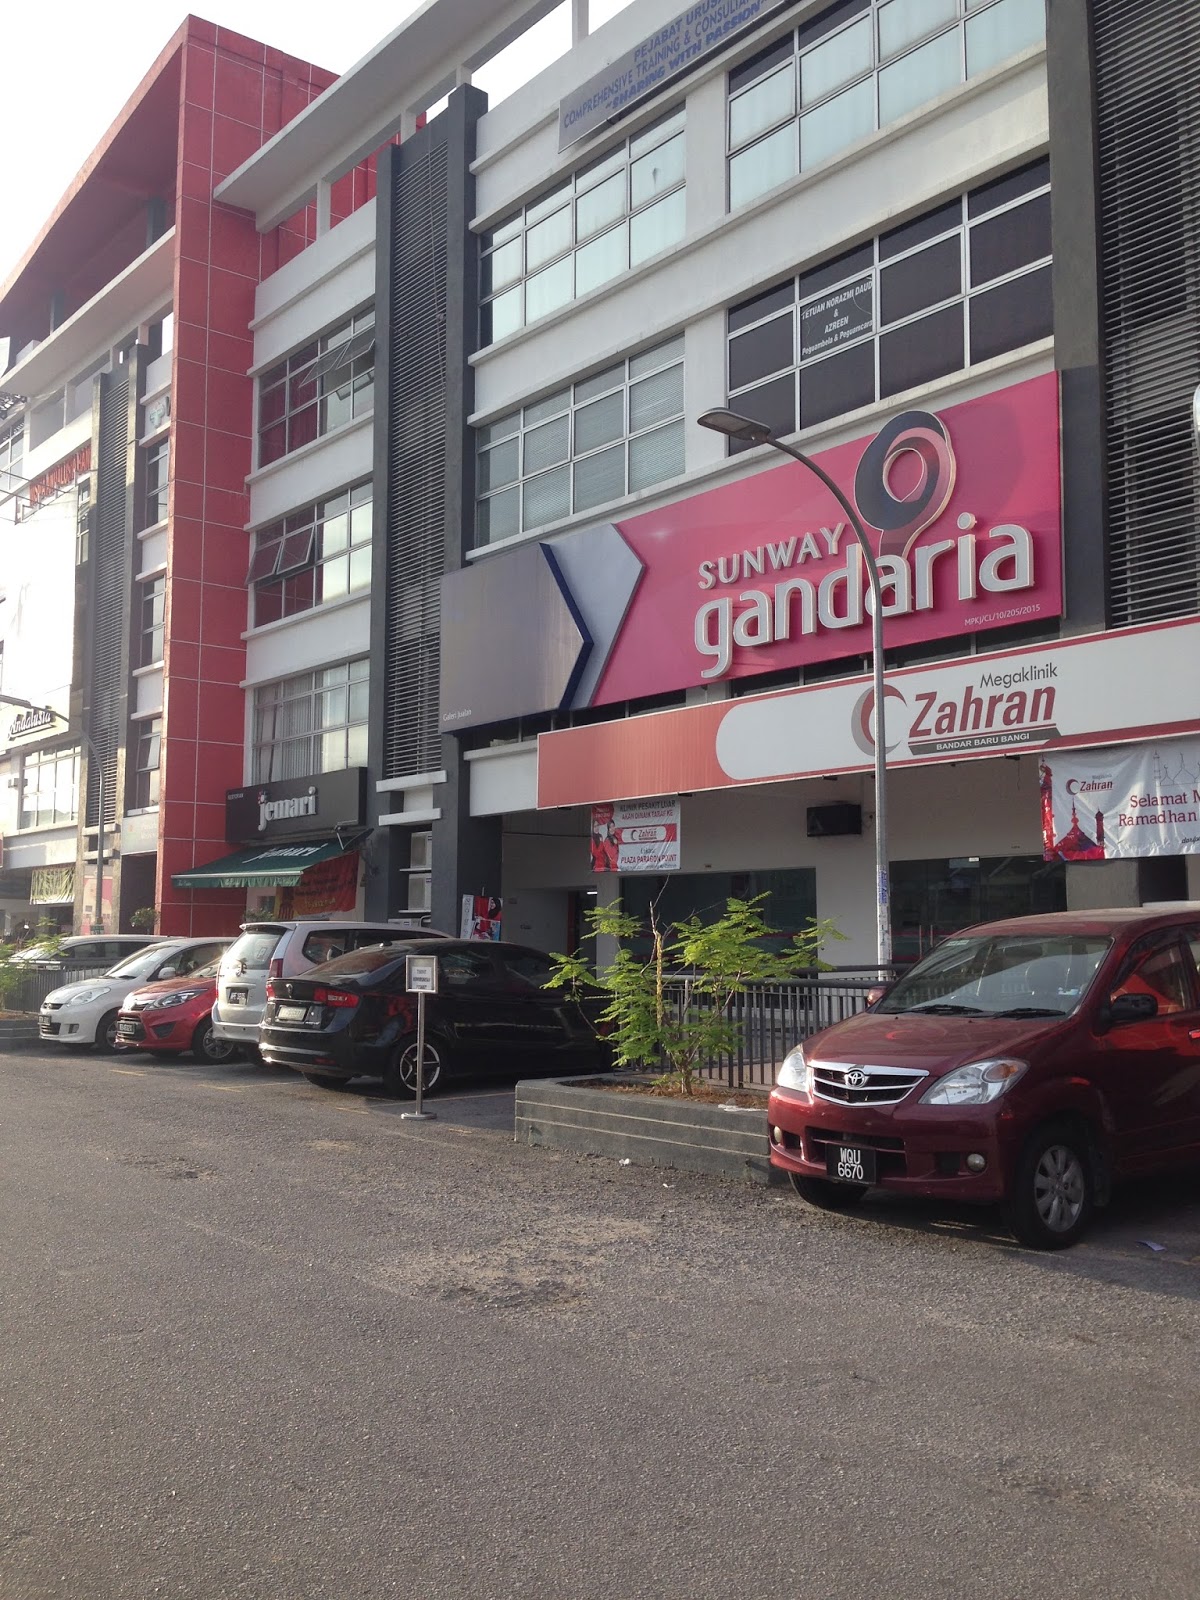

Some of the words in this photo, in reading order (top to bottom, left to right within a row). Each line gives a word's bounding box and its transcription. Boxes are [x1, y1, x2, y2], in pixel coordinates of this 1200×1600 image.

[634, 18, 683, 61] PEJABAT
[686, 0, 722, 26] URUS
[669, 39, 702, 70] WITH
[563, 70, 633, 128] COMPREHENSIVE
[636, 36, 681, 77] TRAINING
[684, 30, 691, 46] &
[801, 302, 826, 320] TETUAN
[826, 289, 854, 308] NORAZMI
[833, 308, 839, 317] &
[824, 315, 849, 334] AZREEN
[698, 522, 847, 590] SUNWAY
[694, 512, 1035, 679] gandaria
[980, 662, 1058, 689] Megaklinik
[908, 685, 1057, 738] Zahran
[936, 739, 972, 751] BANDAR
[974, 736, 999, 747] BARU
[1001, 732, 1030, 744] BANGI
[1079, 779, 1113, 792] Zahran
[257, 786, 316, 832] jemari
[1130, 792, 1188, 808] Selamat
[1118, 810, 1198, 827] Ramadhan
[840, 1147, 861, 1164] WQU
[837, 1162, 864, 1180] 6670
